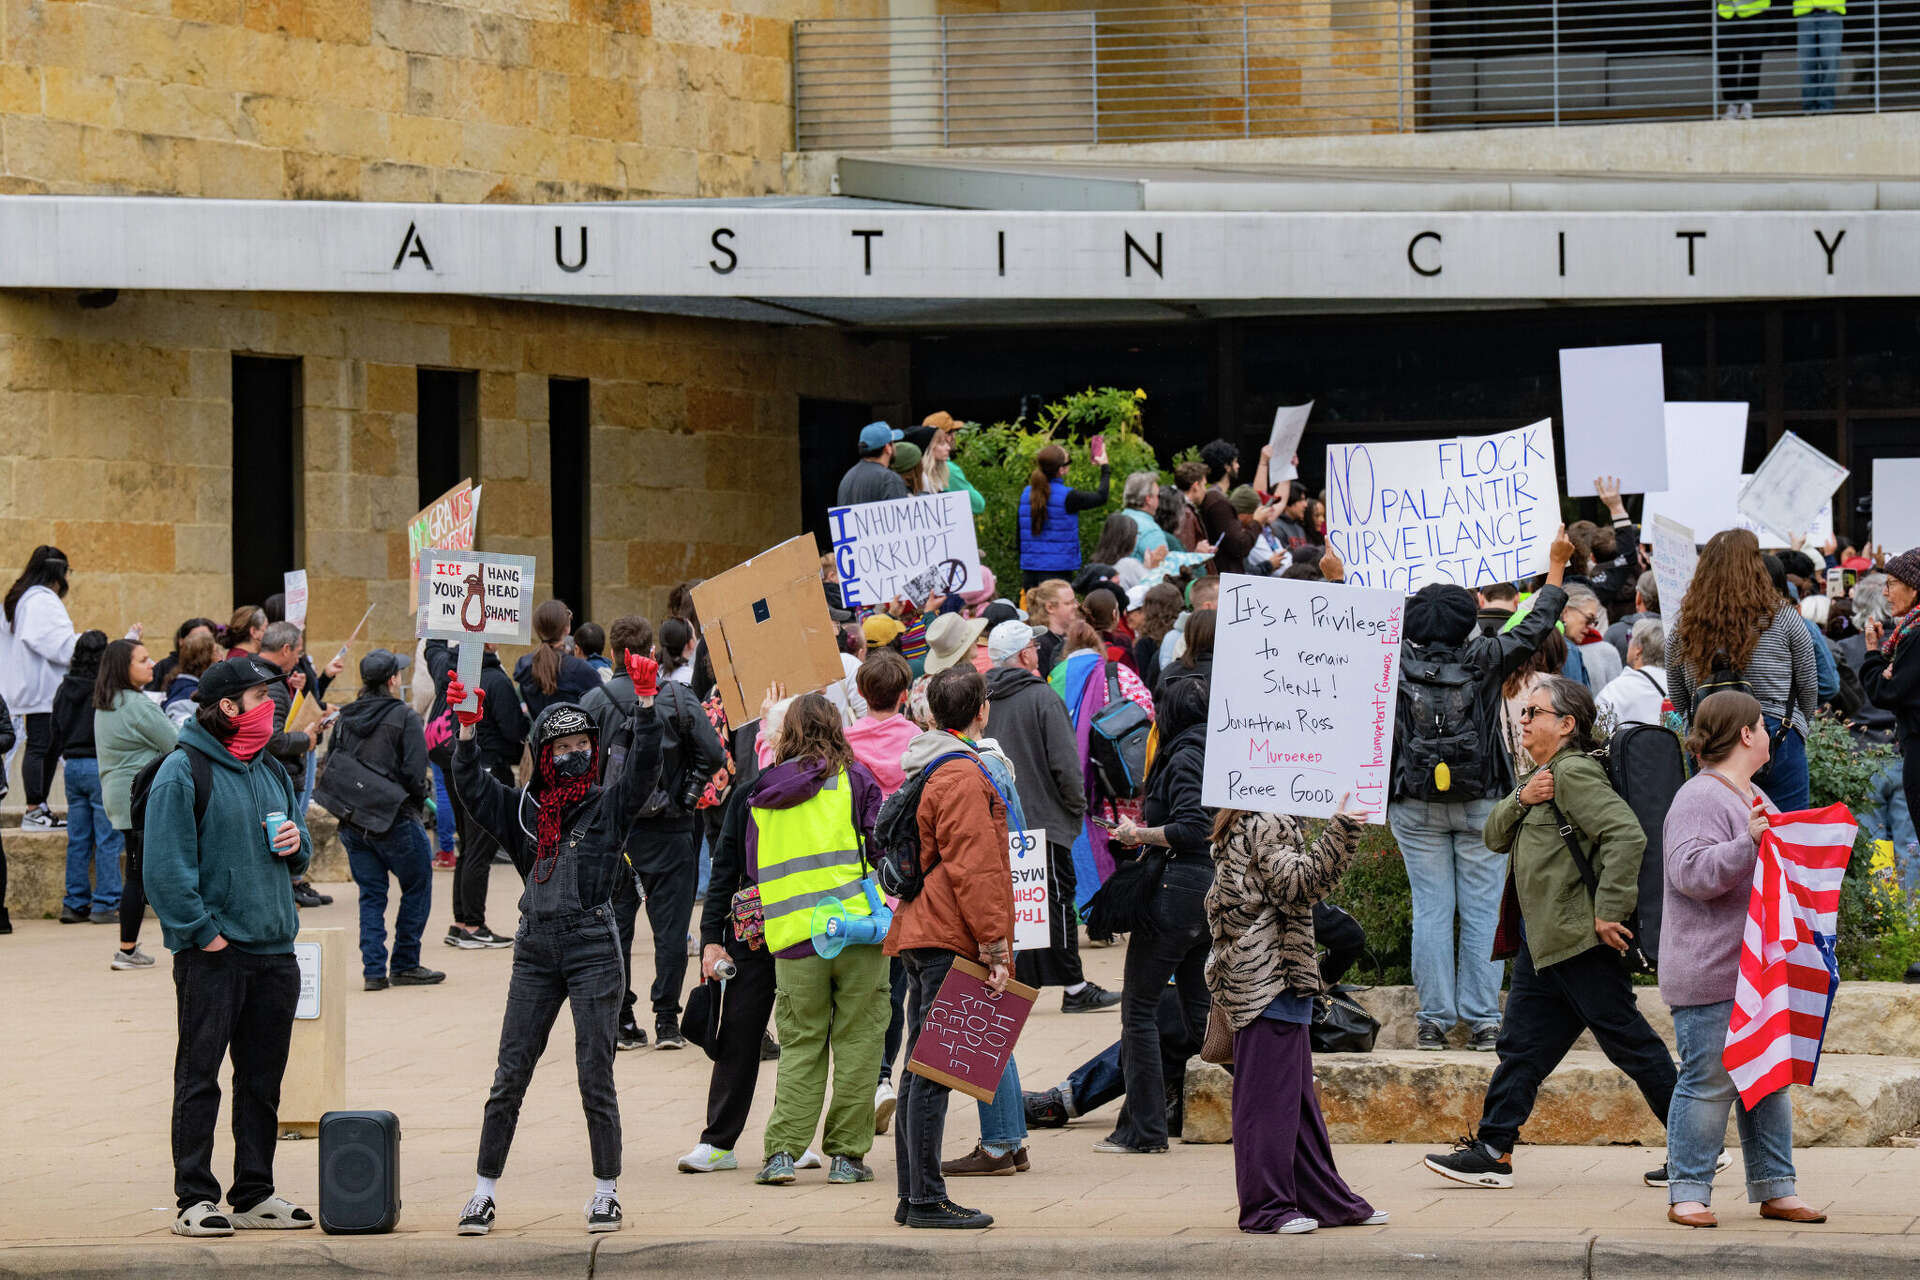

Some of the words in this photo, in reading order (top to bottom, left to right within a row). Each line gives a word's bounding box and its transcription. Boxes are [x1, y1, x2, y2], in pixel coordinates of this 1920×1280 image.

[392, 221, 1164, 277] AUSTIN
[1406, 230, 1847, 278] CITY
[1330, 444, 1375, 527] NO
[1438, 429, 1545, 480] FLOCK
[1381, 471, 1538, 523] PALANTIR
[829, 496, 957, 547] INHUMANE
[436, 564, 462, 577] ICE
[487, 566, 520, 583] HANG
[836, 529, 954, 580] CORRUPT
[1435, 545, 1537, 589] STATE
[432, 581, 465, 598] YOUR
[487, 584, 519, 599] HEAD
[841, 575, 908, 608] EVI
[442, 603, 456, 616] IN
[484, 604, 520, 623] SHAME
[1283, 607, 1297, 625] A
[1310, 595, 1388, 637] Privilege
[1255, 638, 1279, 660] to
[1297, 650, 1350, 666] remain
[1296, 708, 1335, 735] Ross
[1228, 770, 1277, 801] Renee
[926, 999, 954, 1033] ICE
[939, 993, 975, 1056] MELT
[950, 986, 1003, 1075] PEOPLE
[980, 1013, 1017, 1068] HOT
